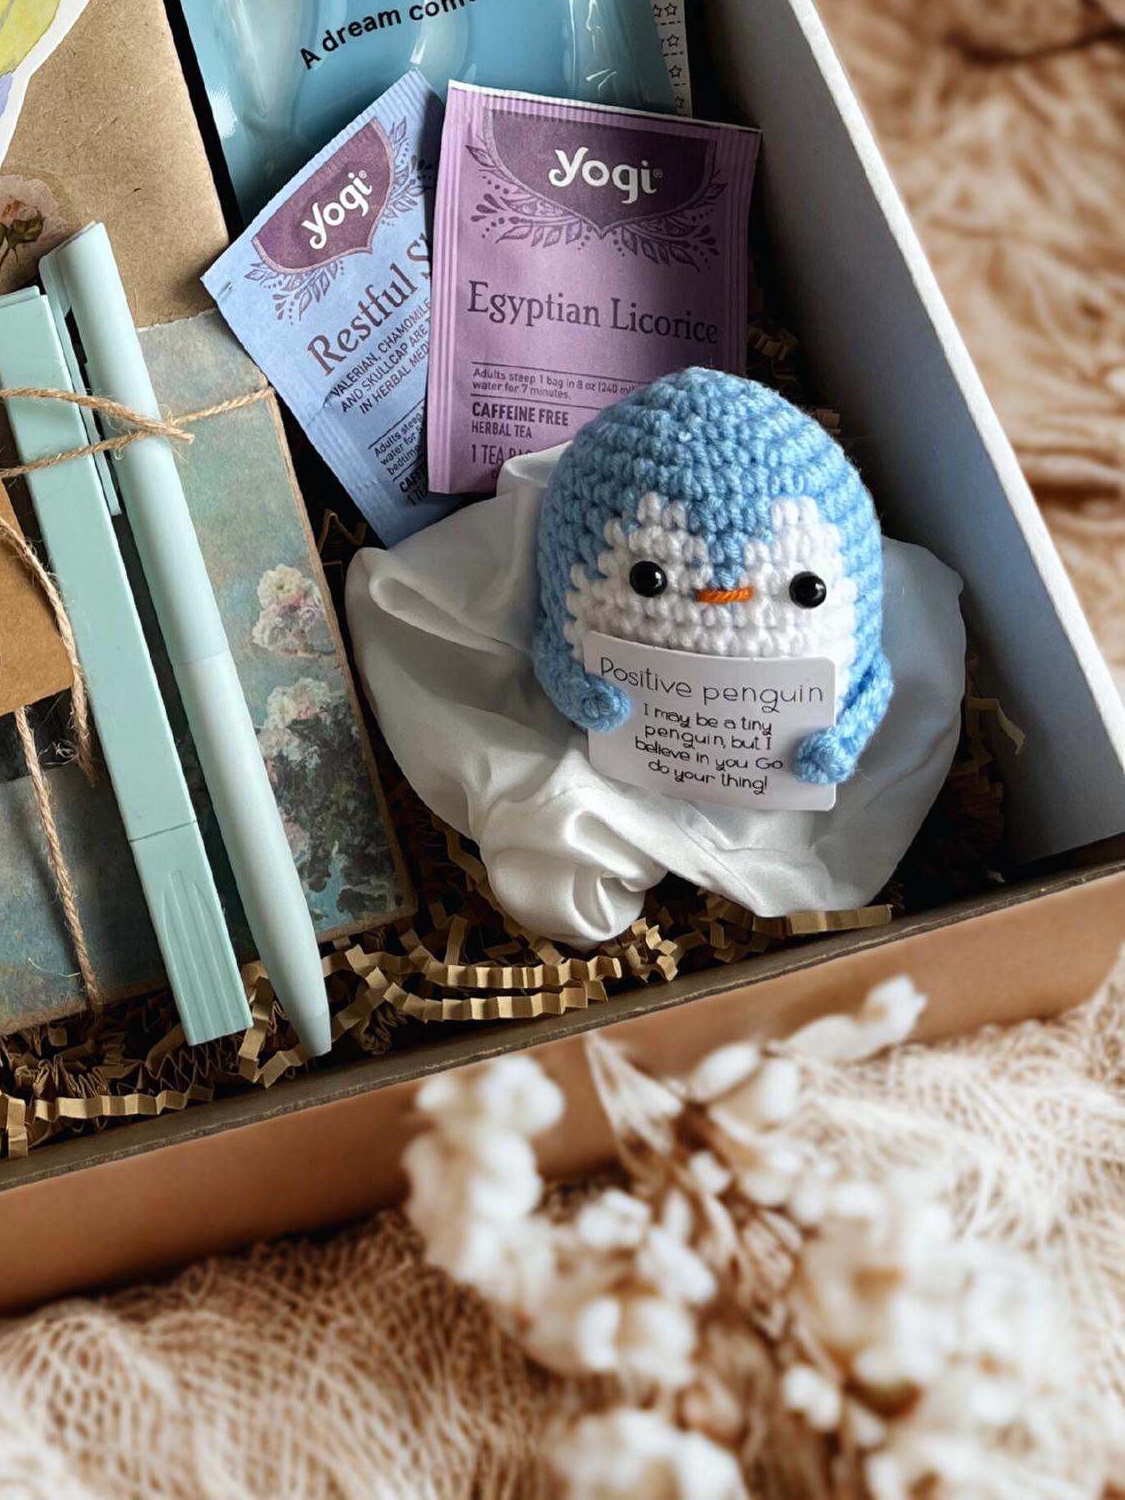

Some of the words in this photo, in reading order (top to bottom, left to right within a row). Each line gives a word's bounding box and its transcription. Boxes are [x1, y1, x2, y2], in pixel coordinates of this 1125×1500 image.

[299, 47, 321, 70] A
[321, 8, 402, 52] dream
[307, 262, 419, 377] Restful
[467, 280, 601, 327] Egyptian
[610, 297, 719, 344] Licorice
[330, 352, 382, 398] VALERIAN,
[340, 387, 364, 414] AND
[362, 341, 410, 394] SKULLCAP
[409, 323, 428, 347] ARE
[472, 367, 507, 381] Adults
[509, 371, 536, 385] steep
[539, 374, 544, 384] 1
[546, 375, 564, 389] bag
[566, 378, 575, 388] in
[585, 383, 596, 391] oz
[359, 398, 374, 414] IN
[373, 364, 411, 403] HERBAL
[472, 381, 503, 393] water
[504, 381, 520, 394] for
[522, 384, 528, 394] 7
[530, 386, 571, 400] minutes.
[471, 402, 536, 423] CAFFEINE
[538, 409, 570, 426] FREE
[471, 420, 512, 437] HERBAL
[514, 423, 532, 439] TEA
[374, 431, 402, 457] Adults
[401, 412, 422, 435] steep
[380, 443, 405, 466] water
[403, 431, 417, 446] for
[471, 444, 476, 463] 1
[481, 444, 504, 466] TEA
[600, 656, 692, 698] Positive
[703, 684, 824, 713] penguin
[643, 703, 649, 716] I
[654, 707, 691, 729] may
[696, 712, 718, 728] be
[724, 719, 736, 729] a
[741, 716, 772, 736] tiny
[644, 724, 726, 749] penguin,
[731, 734, 762, 750] but
[766, 736, 772, 750] I
[634, 736, 691, 761] believe
[696, 751, 710, 765] in
[716, 757, 749, 772] you
[755, 757, 784, 770] Go
[648, 759, 670, 775] do
[674, 767, 716, 784] your
[721, 771, 768, 795] thing!
